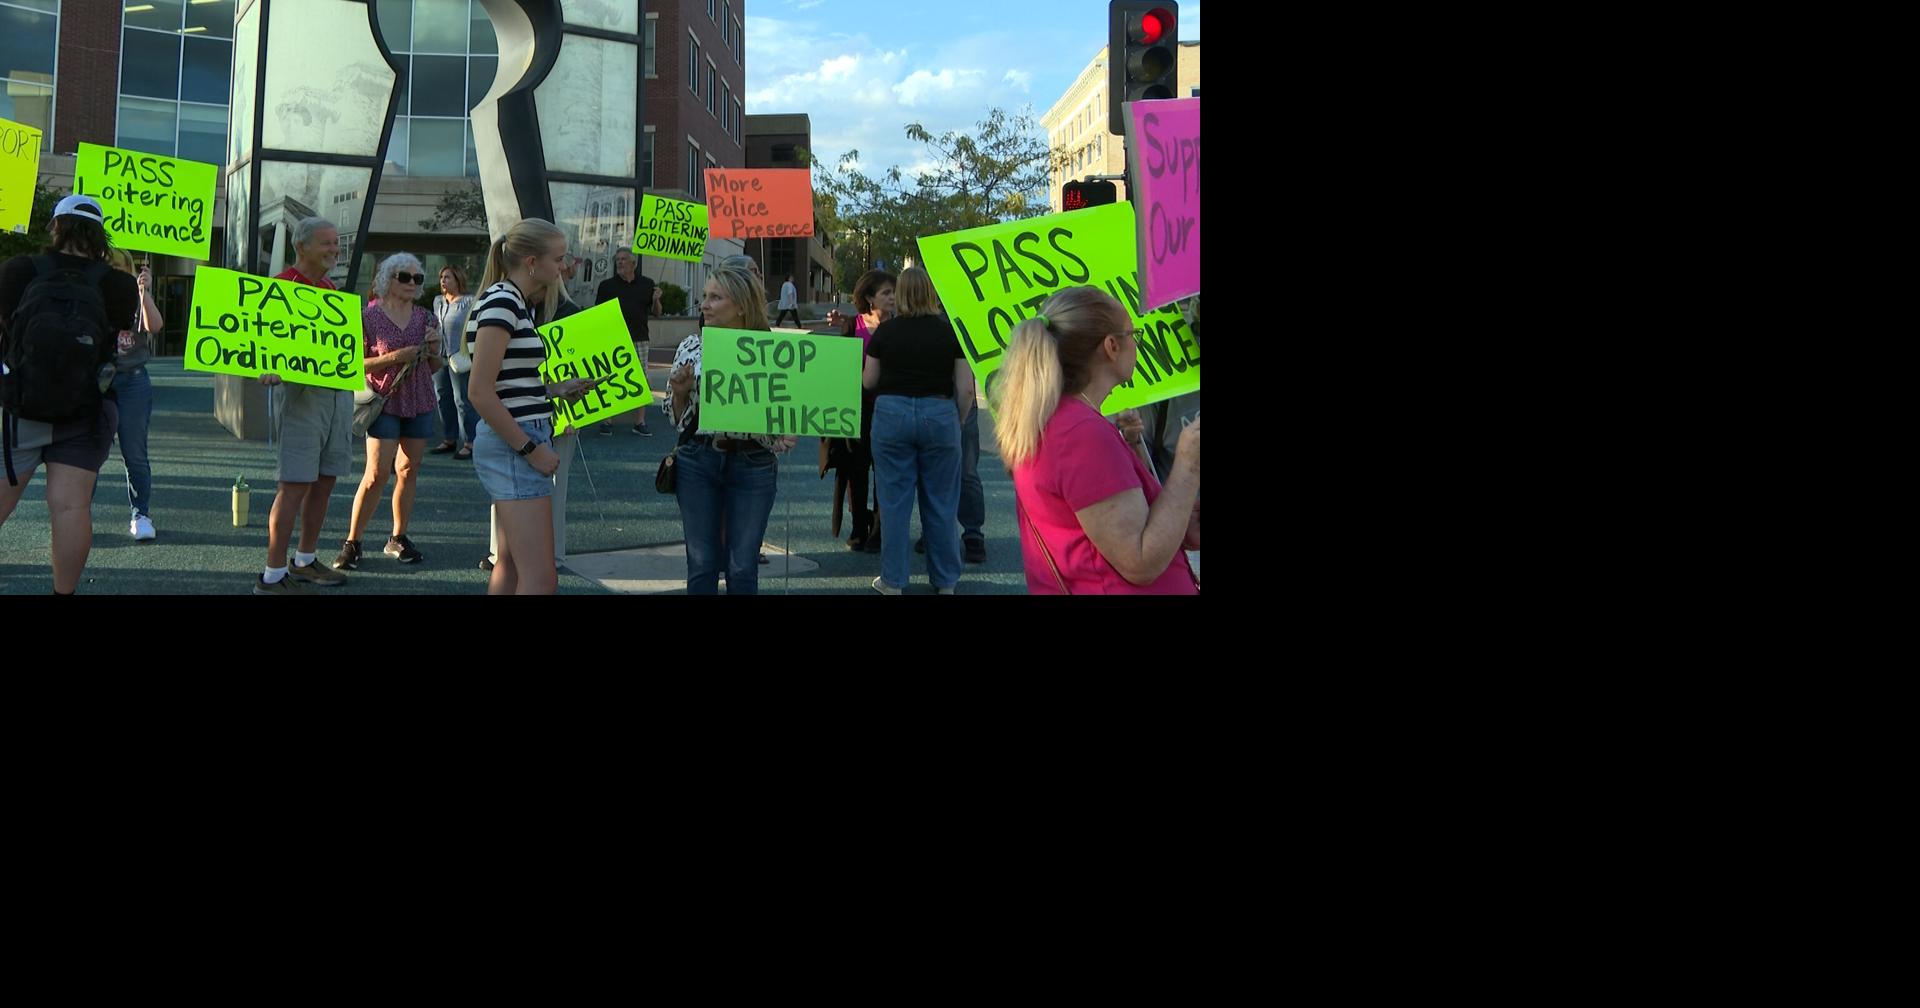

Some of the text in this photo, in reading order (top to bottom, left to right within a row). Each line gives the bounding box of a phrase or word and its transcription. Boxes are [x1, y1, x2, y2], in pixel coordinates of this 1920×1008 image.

[104, 151, 175, 187] PASS
[708, 173, 763, 192] More
[78, 176, 204, 229] Loitering
[655, 199, 695, 222] PASS
[709, 195, 769, 218] Police
[103, 208, 205, 244] rdinance
[639, 216, 708, 242] LOITERING
[731, 219, 813, 238] Presence
[1150, 202, 1194, 265] Our
[636, 232, 705, 257] ORDINANCE
[951, 227, 1090, 302] PASS
[238, 276, 348, 326] PASS
[195, 305, 356, 365] Loitering
[195, 336, 357, 379] Ordinance
[736, 336, 817, 373] STOP
[705, 369, 791, 405] RATE
[766, 404, 856, 436] HIKES
